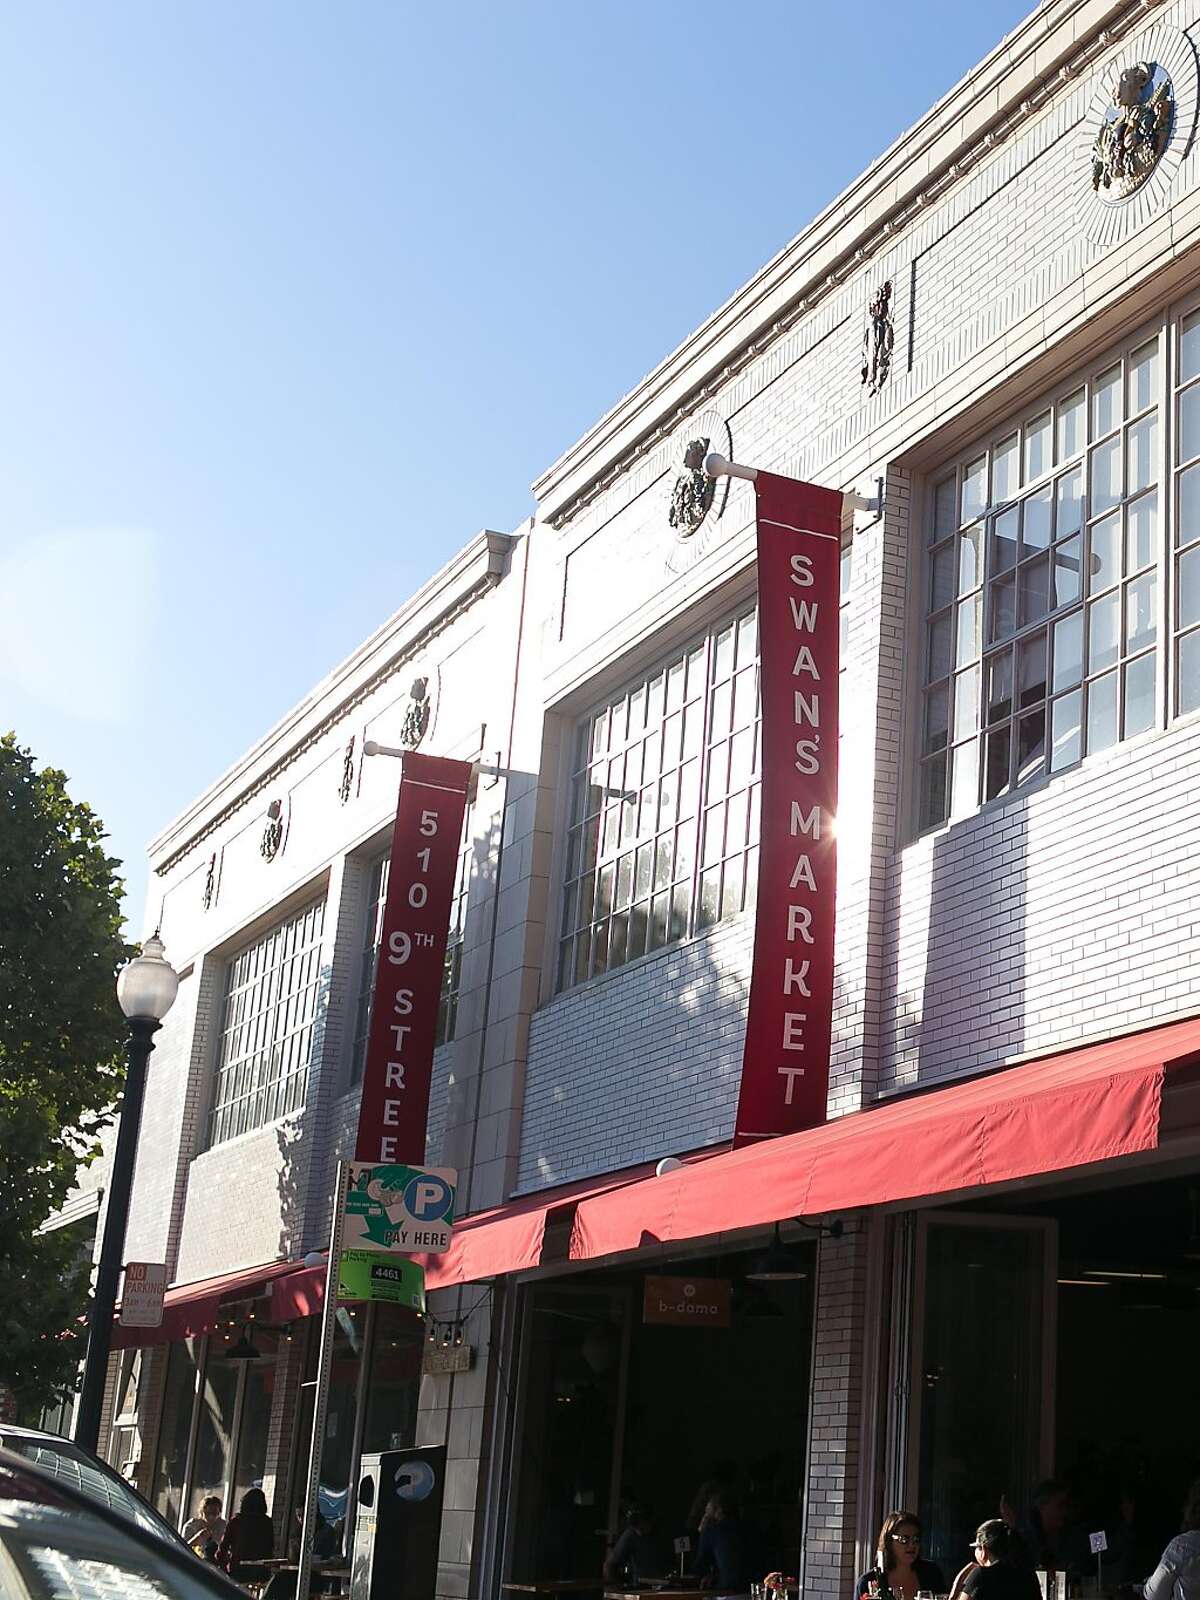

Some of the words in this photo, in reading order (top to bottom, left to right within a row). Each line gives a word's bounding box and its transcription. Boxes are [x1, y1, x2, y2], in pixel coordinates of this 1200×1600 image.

[789, 555, 821, 775] SWAN'S
[408, 809, 439, 909] 510
[387, 930, 434, 966] 9TH
[777, 801, 821, 1104] MARKET
[380, 989, 414, 1162] STREE
[384, 1230, 408, 1245] PAY
[414, 1231, 447, 1246] HERE
[127, 1280, 164, 1296] PARKING
[130, 1266, 145, 1279] NO
[659, 1299, 719, 1314] b-dama
